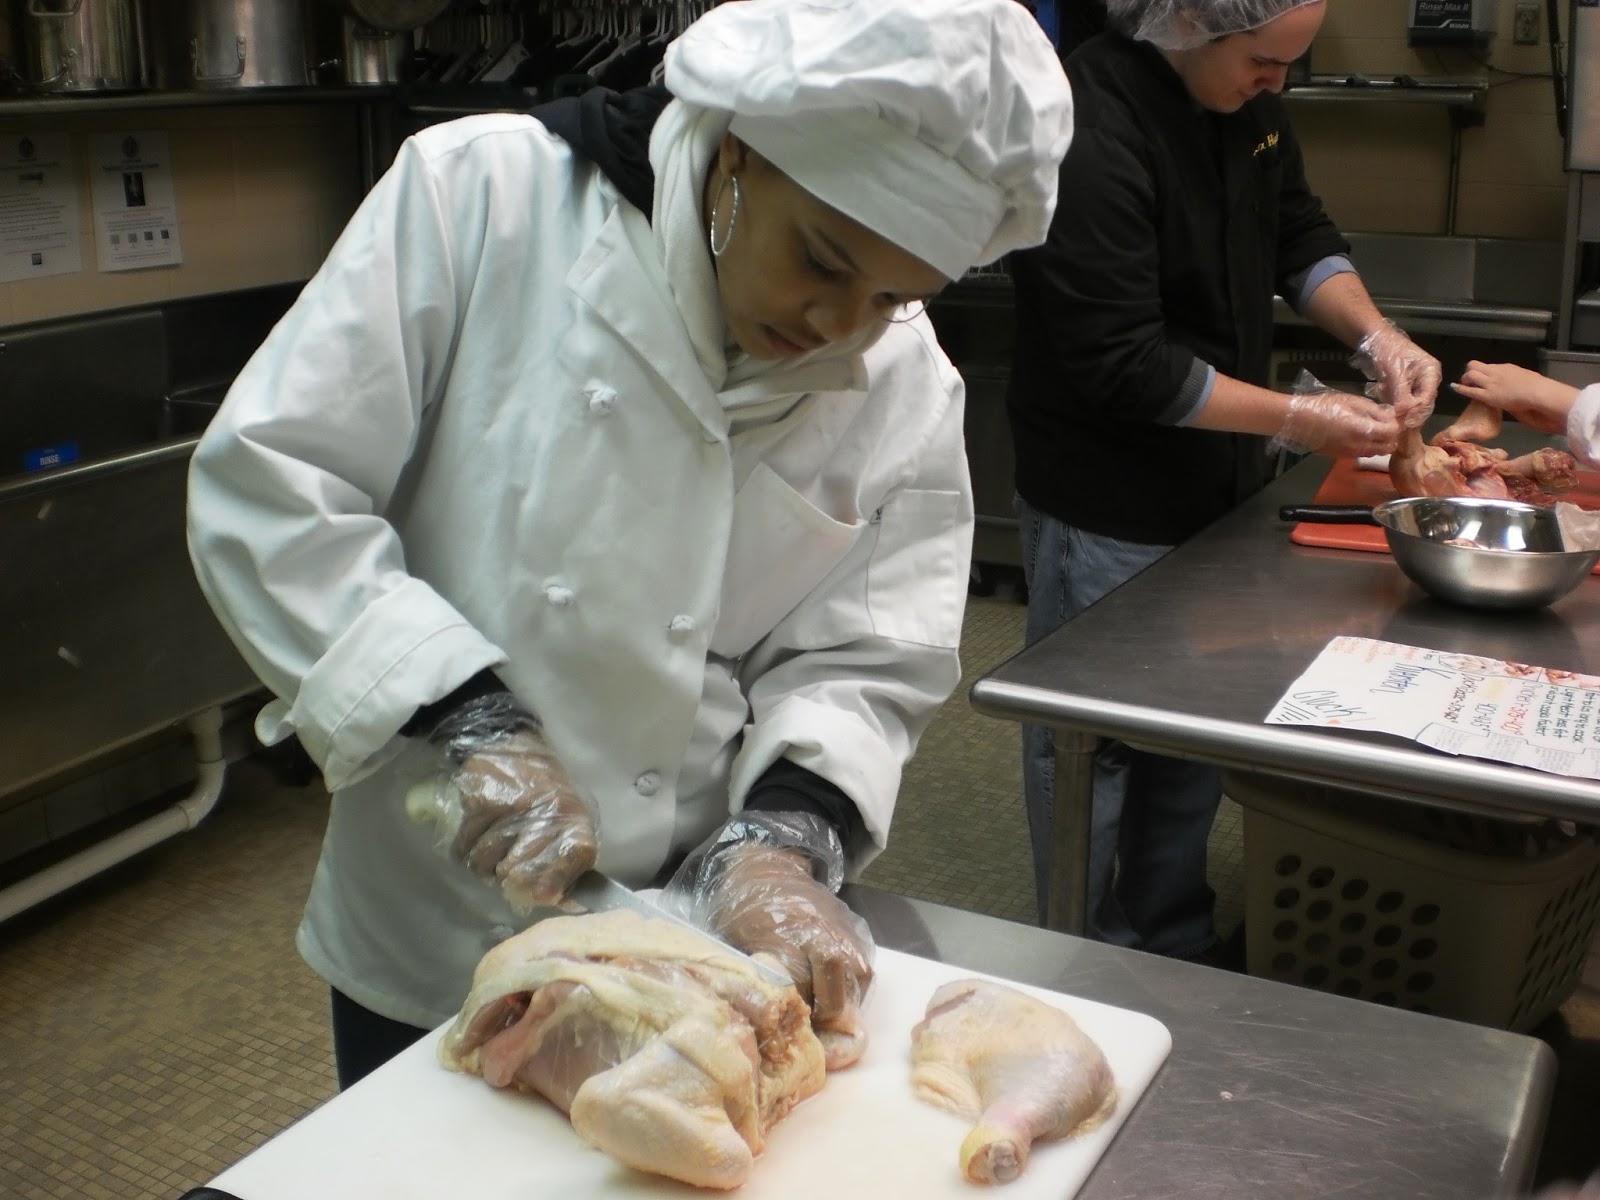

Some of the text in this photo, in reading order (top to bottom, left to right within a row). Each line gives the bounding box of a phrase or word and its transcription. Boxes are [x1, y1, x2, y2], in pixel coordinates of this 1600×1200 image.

[1419, 2, 1442, 11] Rinse
[1444, 3, 1462, 11] Max
[40, 454, 60, 466] RINSE
